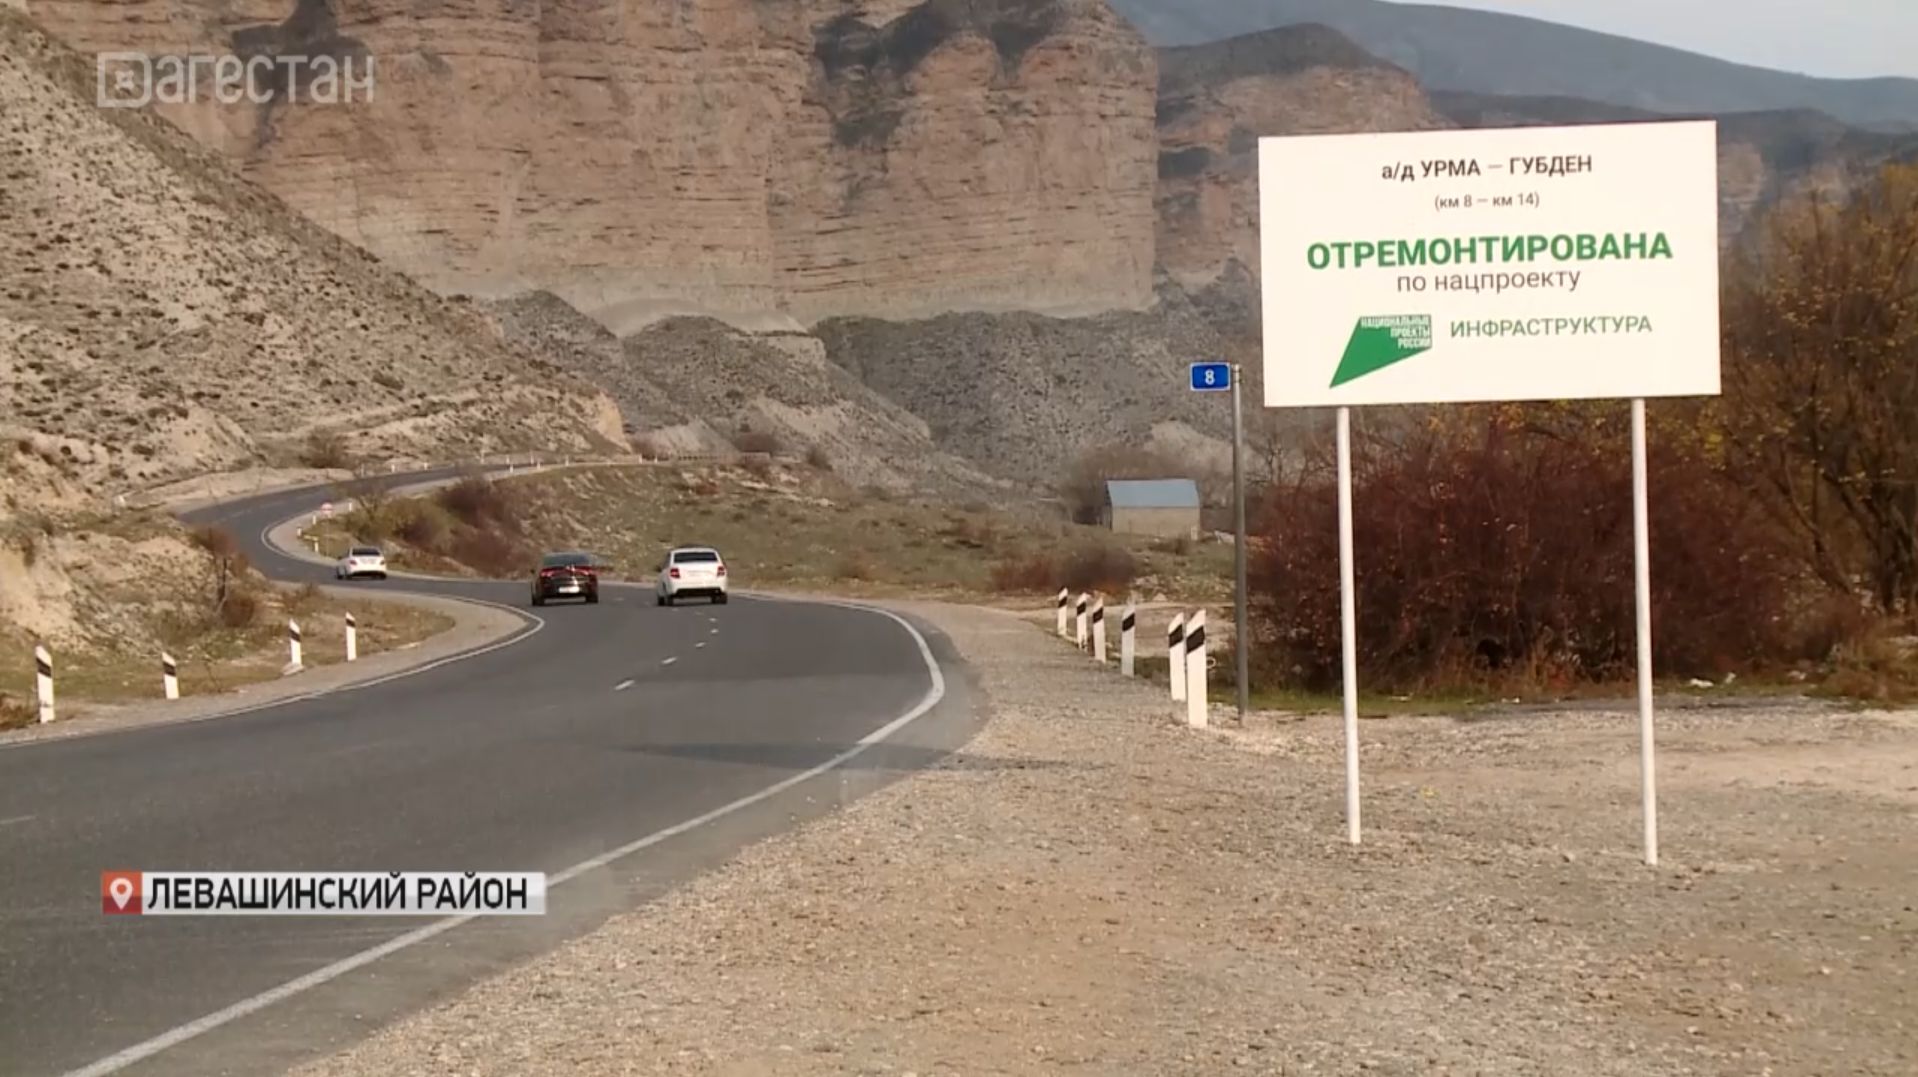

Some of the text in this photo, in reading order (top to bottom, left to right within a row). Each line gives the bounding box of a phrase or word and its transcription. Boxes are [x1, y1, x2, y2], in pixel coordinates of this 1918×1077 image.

[1381, 161, 1415, 182] а/д
[1421, 159, 1481, 177] УРМА
[1509, 154, 1593, 178] ГУБДЕН
[1434, 194, 1459, 212] (км
[1463, 193, 1473, 208] 8
[1492, 195, 1513, 207] км
[1518, 191, 1540, 208] 14)
[1307, 231, 1673, 270] ОТРЕМОНТИРОВАНА
[1397, 270, 1581, 295] по нацпроекту
[1450, 314, 1653, 338] ИНФРАСТРУКТУРА
[1204, 368, 1216, 386] 8
